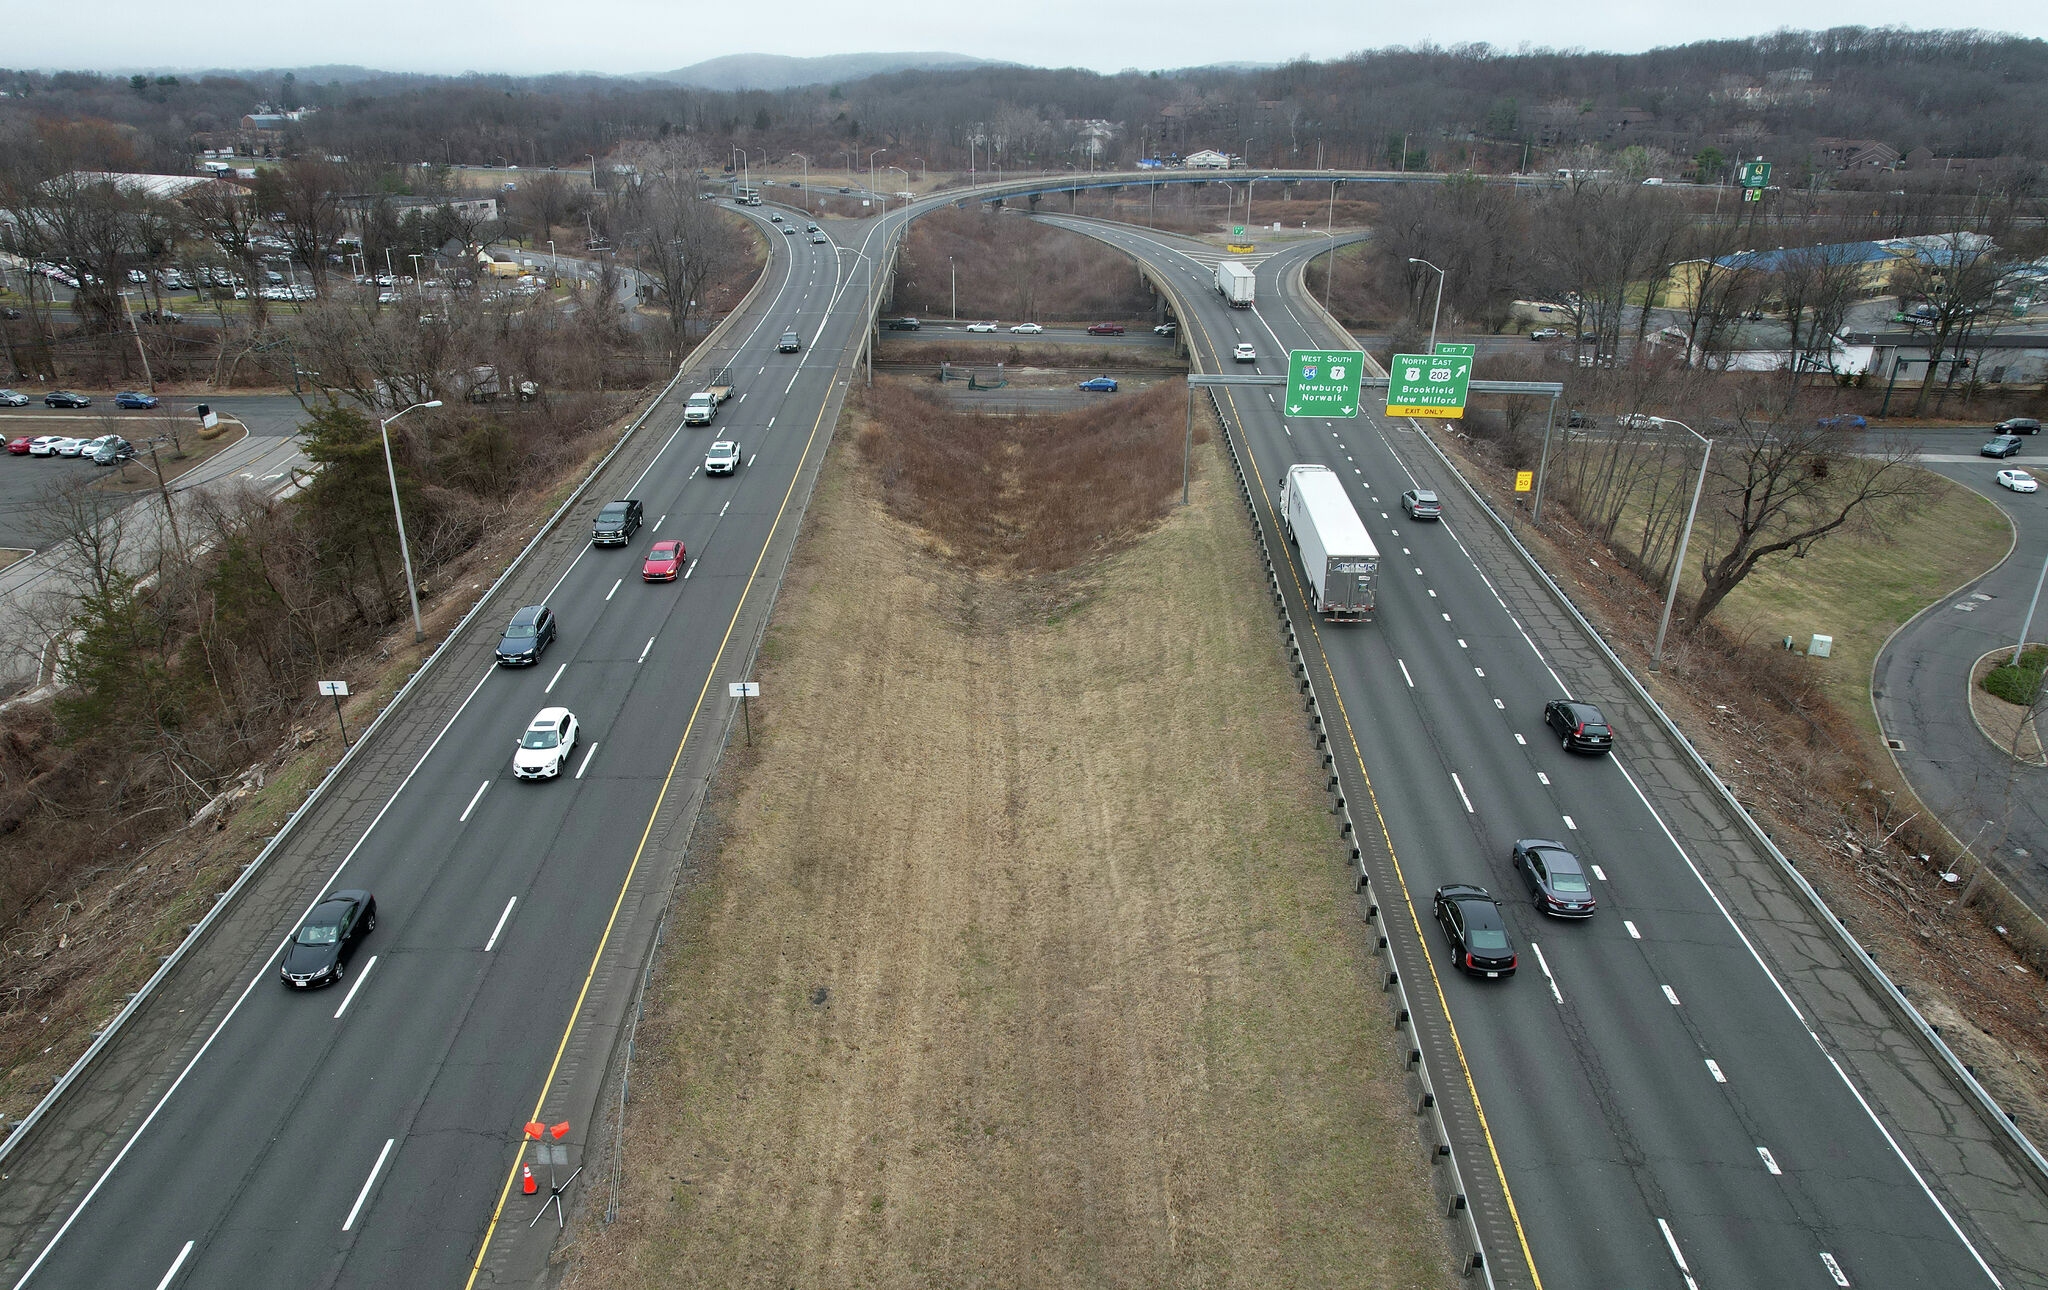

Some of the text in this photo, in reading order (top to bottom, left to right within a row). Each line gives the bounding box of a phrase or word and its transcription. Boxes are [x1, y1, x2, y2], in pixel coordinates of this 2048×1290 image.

[1304, 368, 1315, 377] 84
[1335, 369, 1340, 377] 7
[1299, 384, 1348, 393] Newburgh
[1402, 386, 1454, 394] Brookfield
